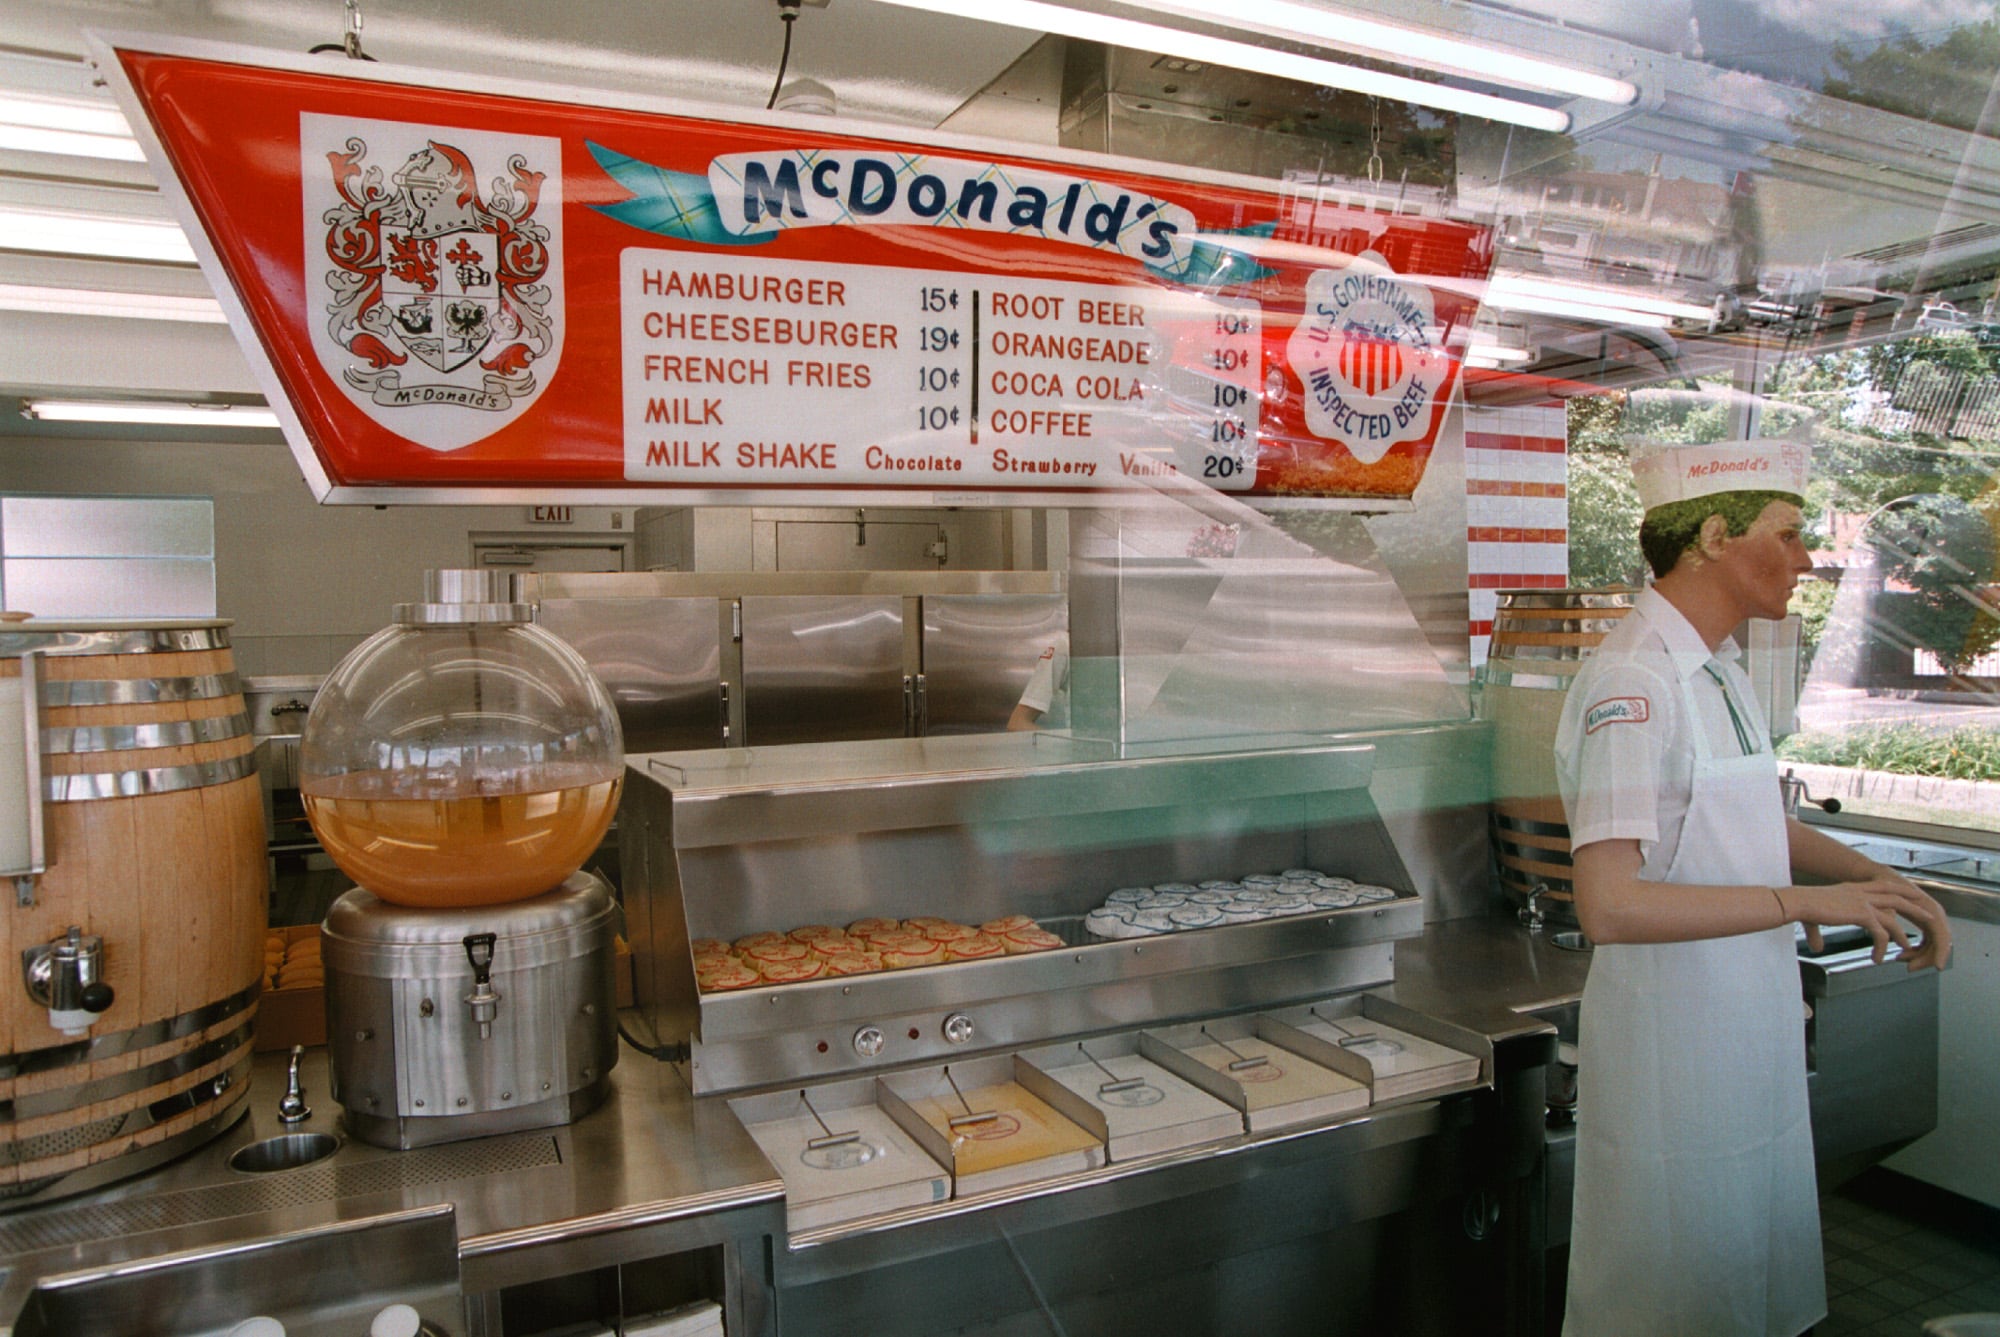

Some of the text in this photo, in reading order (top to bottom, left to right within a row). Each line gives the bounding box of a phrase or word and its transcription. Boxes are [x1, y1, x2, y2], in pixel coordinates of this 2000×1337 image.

[743, 158, 1178, 259] McDonald's
[643, 268, 959, 312] HAMBURGER 15¢
[992, 292, 1249, 335] ROOT BEER 10¢
[1308, 275, 1431, 348] U.S. GOVERNME
[643, 312, 960, 351] CHEESEBURGER 19¢
[992, 331, 1248, 371] ORANGEADE 10¢
[644, 355, 960, 391] FRENCH FRIES 10¢
[991, 371, 1247, 407] COCA COLA 10¢
[394, 388, 498, 408] McDonald's
[645, 398, 960, 430] MILK 10¢
[1309, 366, 1429, 440] INSPECTED BEEF
[991, 409, 1246, 442] COFFEE 10¢
[645, 441, 721, 467] MILK
[736, 442, 837, 469] SHAKE
[865, 446, 962, 471] Chocolate
[992, 448, 1097, 476] Strawberry
[1203, 455, 1245, 478] 20¢
[1687, 457, 1770, 479] McDonald's
